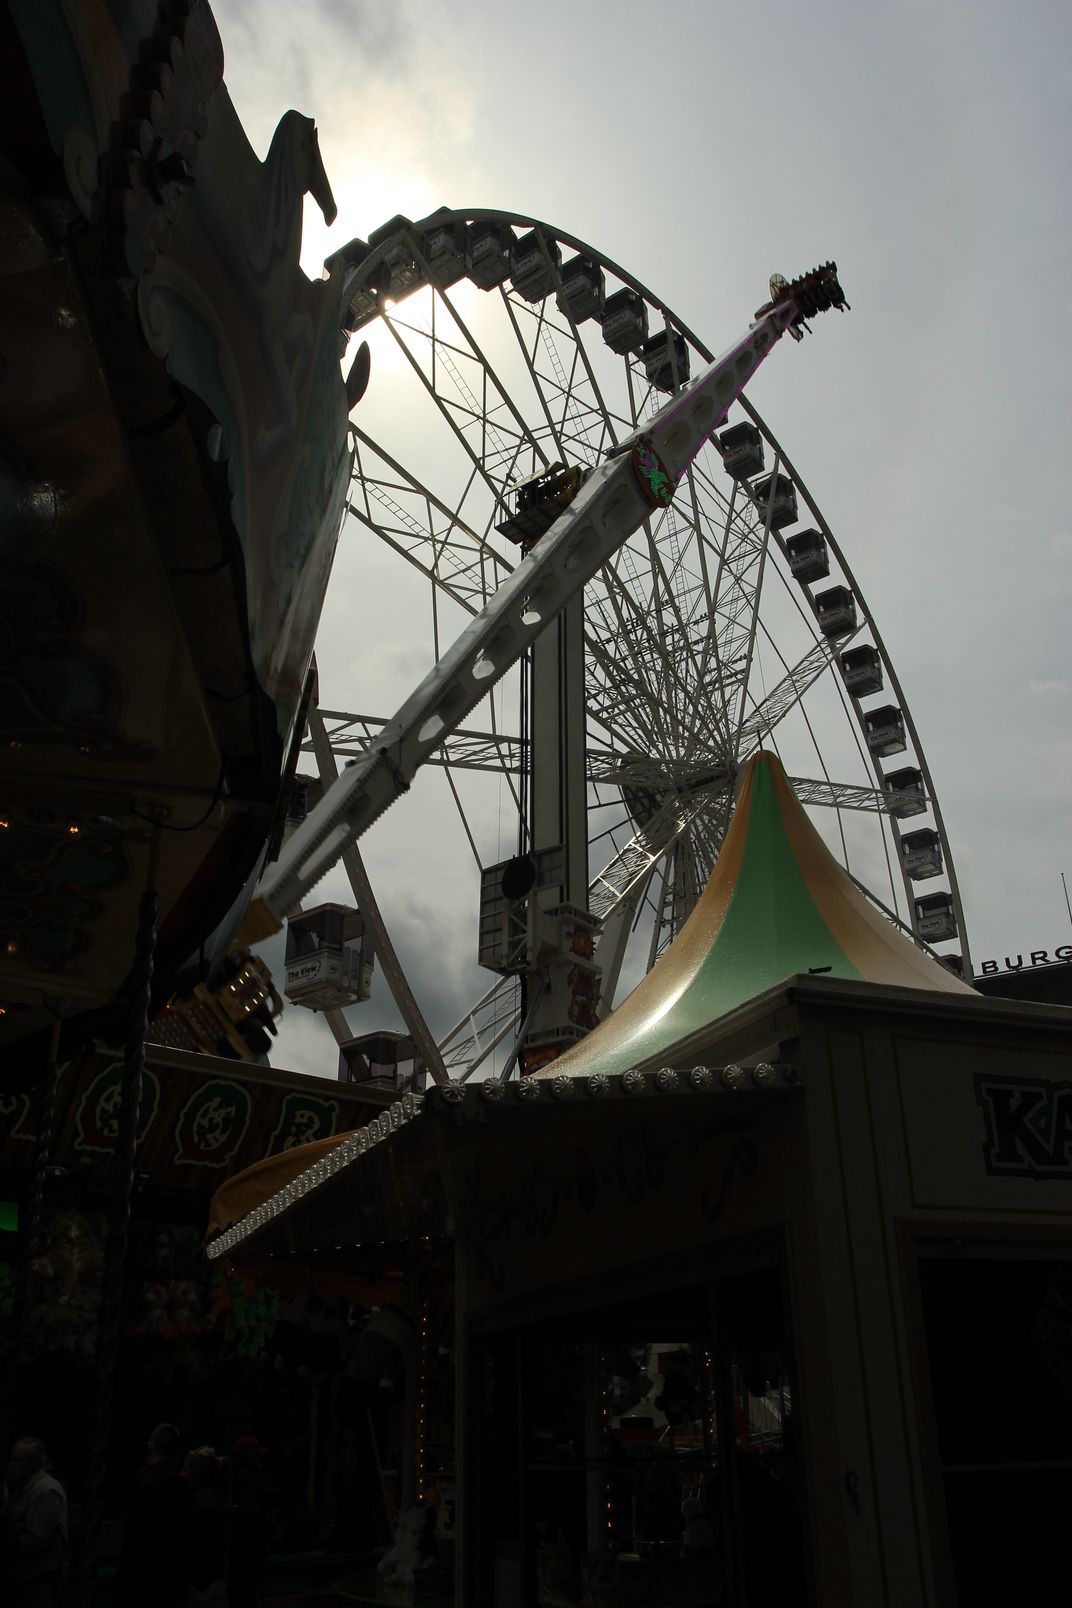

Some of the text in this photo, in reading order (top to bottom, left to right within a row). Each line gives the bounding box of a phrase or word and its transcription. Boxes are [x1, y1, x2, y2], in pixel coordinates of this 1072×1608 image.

[981, 945, 1072, 974] BURG
[288, 970, 300, 980] The
[300, 965, 318, 977] View
